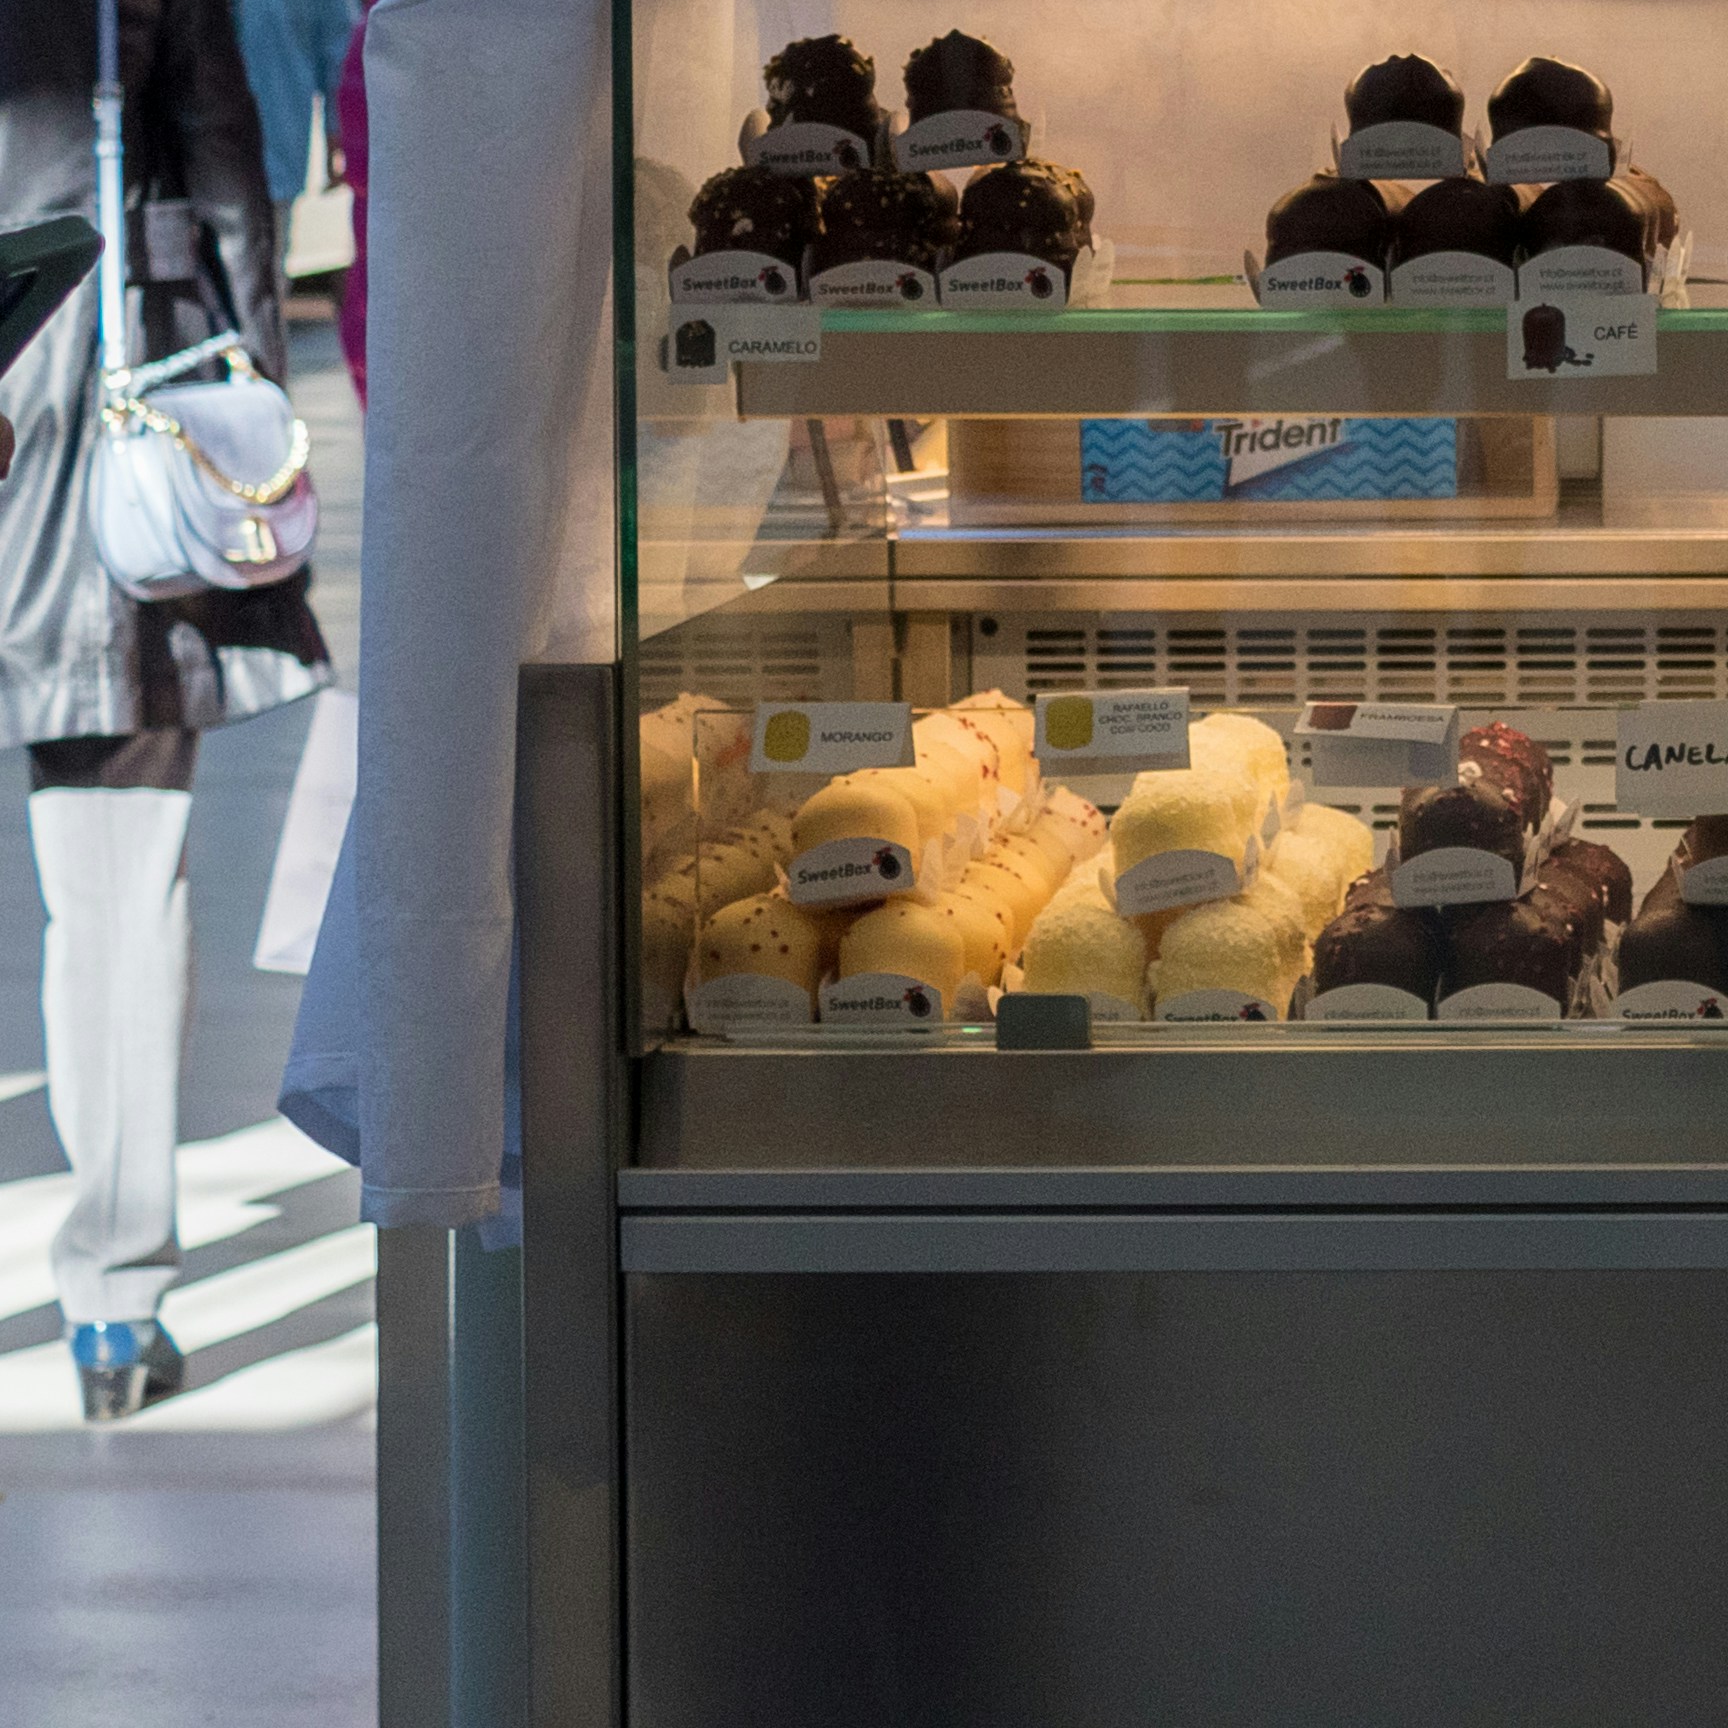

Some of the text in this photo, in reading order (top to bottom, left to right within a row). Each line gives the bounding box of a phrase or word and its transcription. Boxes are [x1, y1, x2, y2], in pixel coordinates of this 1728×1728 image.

[908, 136, 983, 158] SweetBox
[759, 148, 832, 164] SweetBox
[682, 275, 757, 291] SweetBox
[818, 280, 894, 297] SweetBox
[948, 276, 1024, 292] SweetBox
[1267, 276, 1342, 292] SweetBox
[1594, 322, 1638, 342] CAFÉ
[728, 339, 818, 355] CARAMELO
[1212, 419, 1344, 457] Trident
[820, 730, 894, 743] MORANGO
[797, 860, 872, 885] SweetBox
[828, 997, 903, 1012] SweetBox
